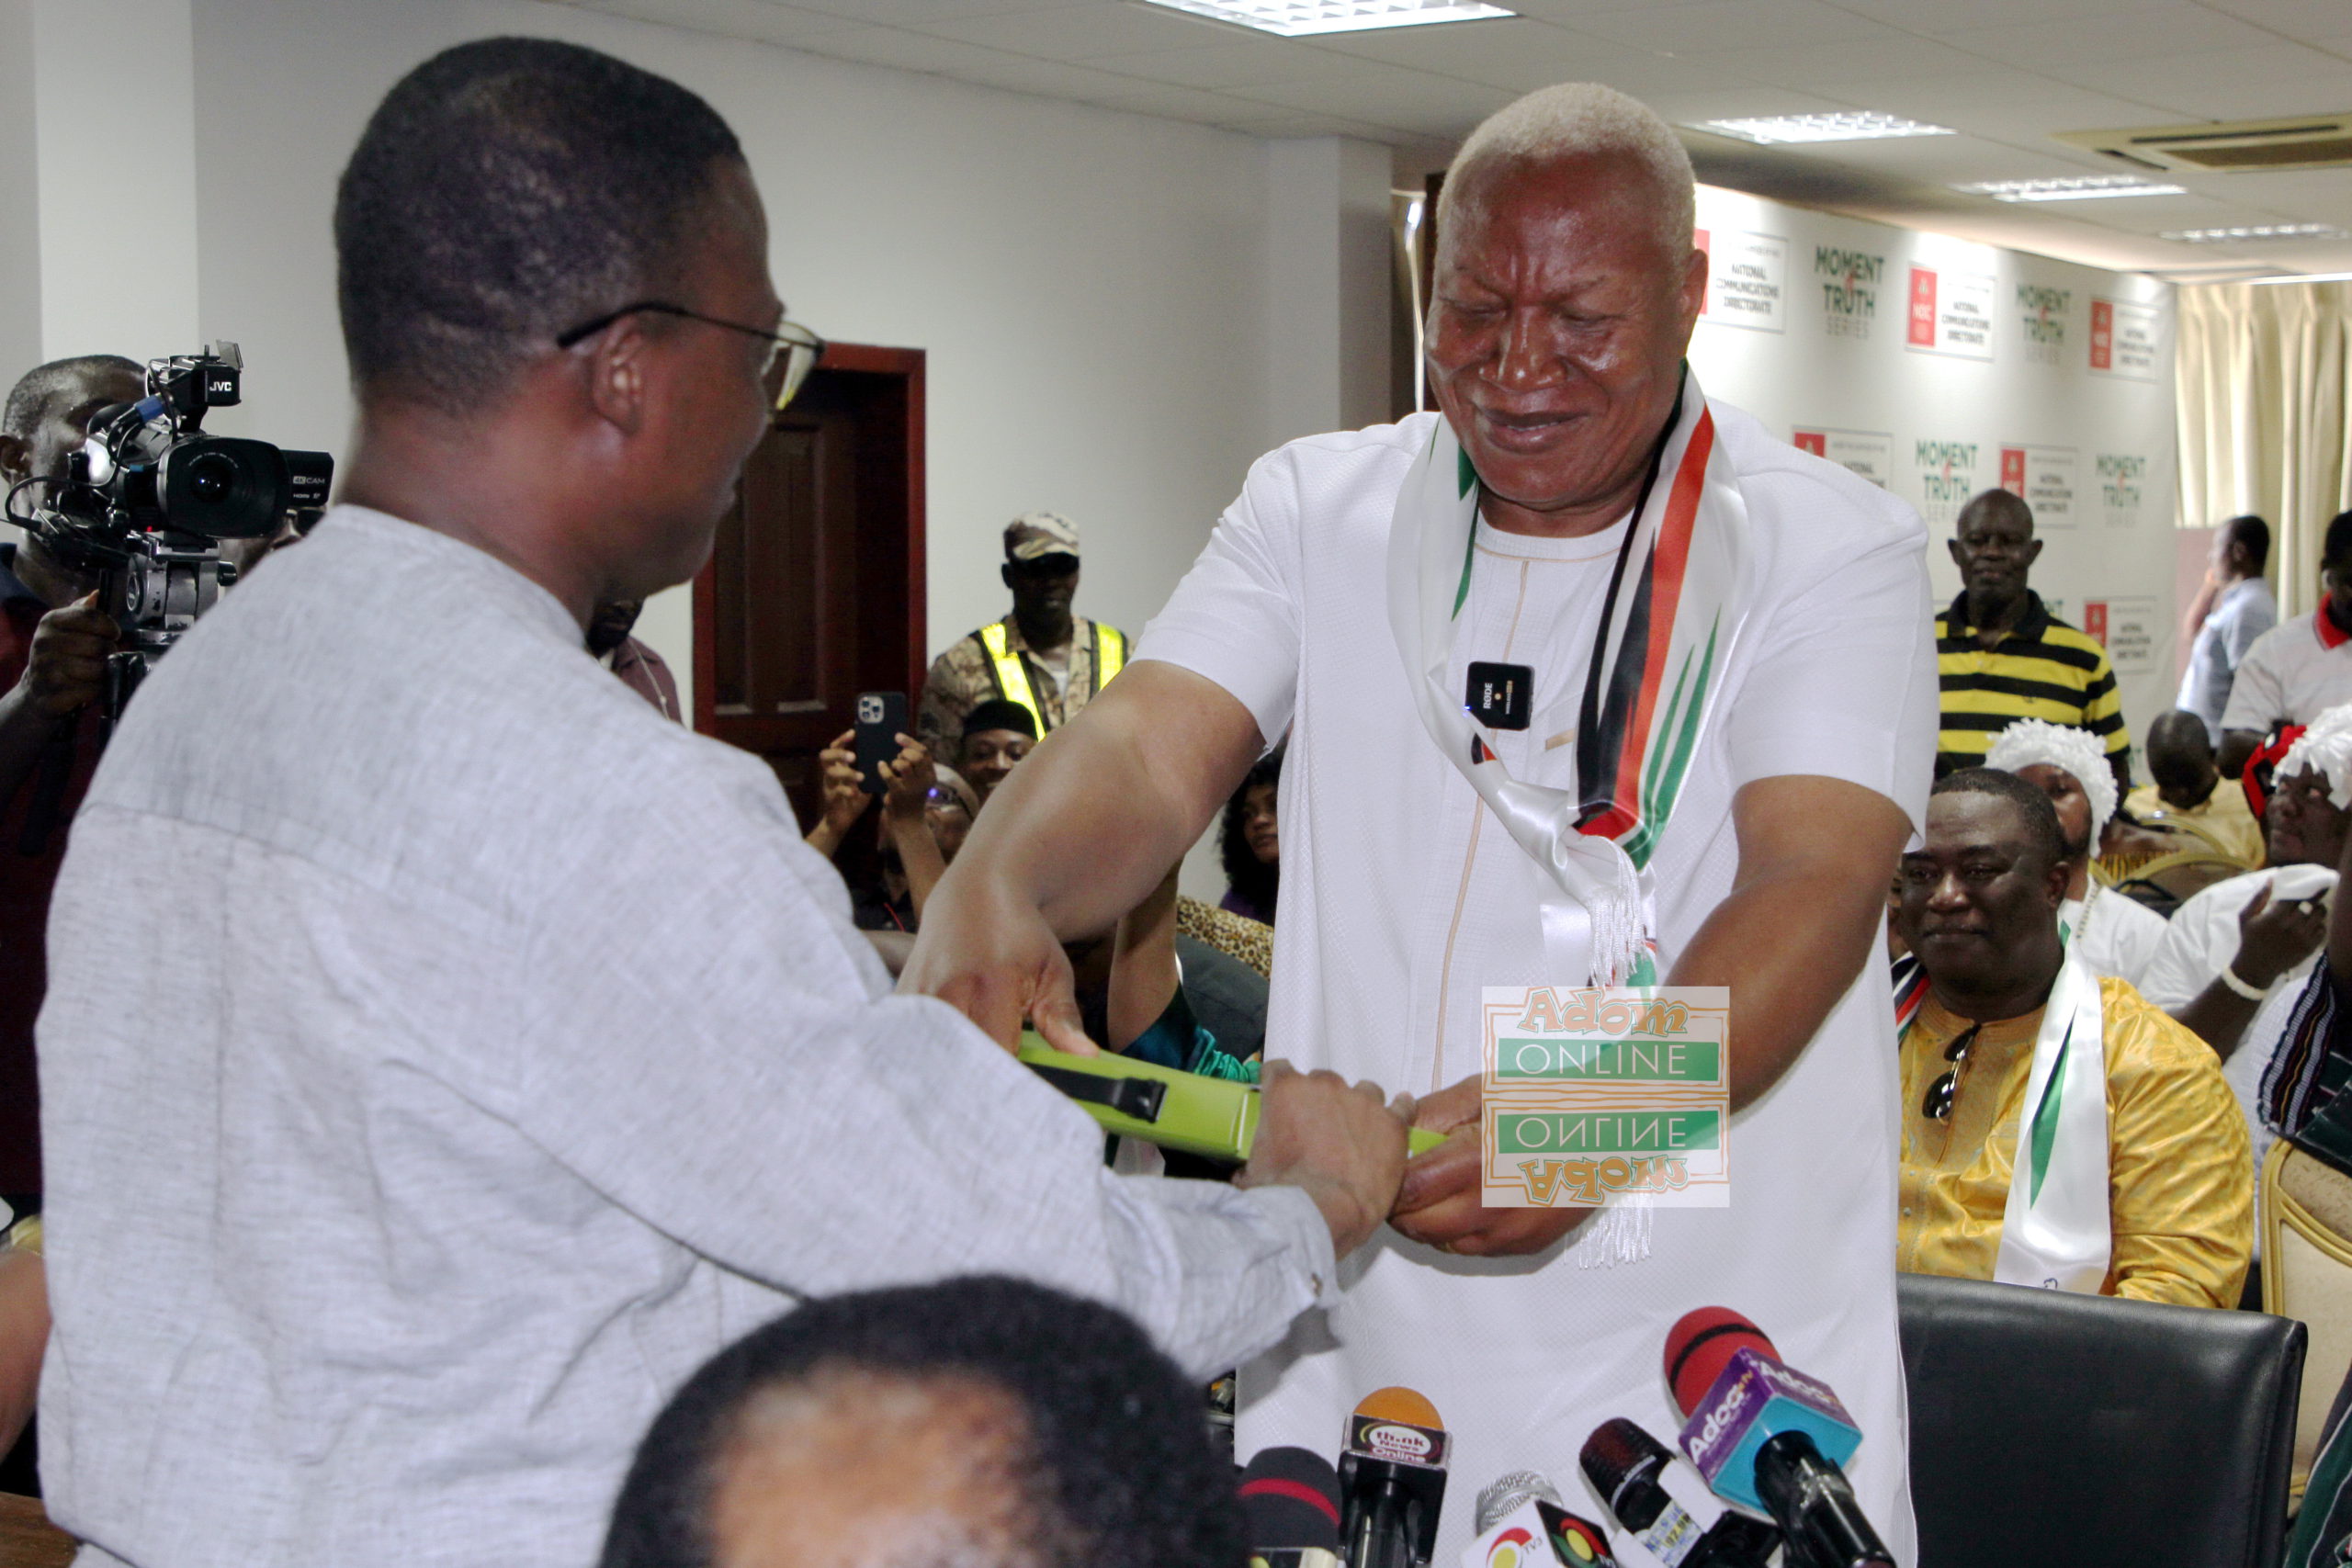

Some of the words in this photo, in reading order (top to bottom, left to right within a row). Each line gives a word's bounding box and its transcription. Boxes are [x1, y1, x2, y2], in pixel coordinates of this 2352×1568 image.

[1815, 244, 1884, 284] MOMENT
[1823, 283, 1876, 318] TRUTH
[209, 381, 232, 392] JVC
[1916, 440, 1977, 468] MOMENT
[2096, 454, 2146, 479] MOMENT
[1924, 474, 1971, 502] TRUTH
[2101, 484, 2142, 508] TRUTH
